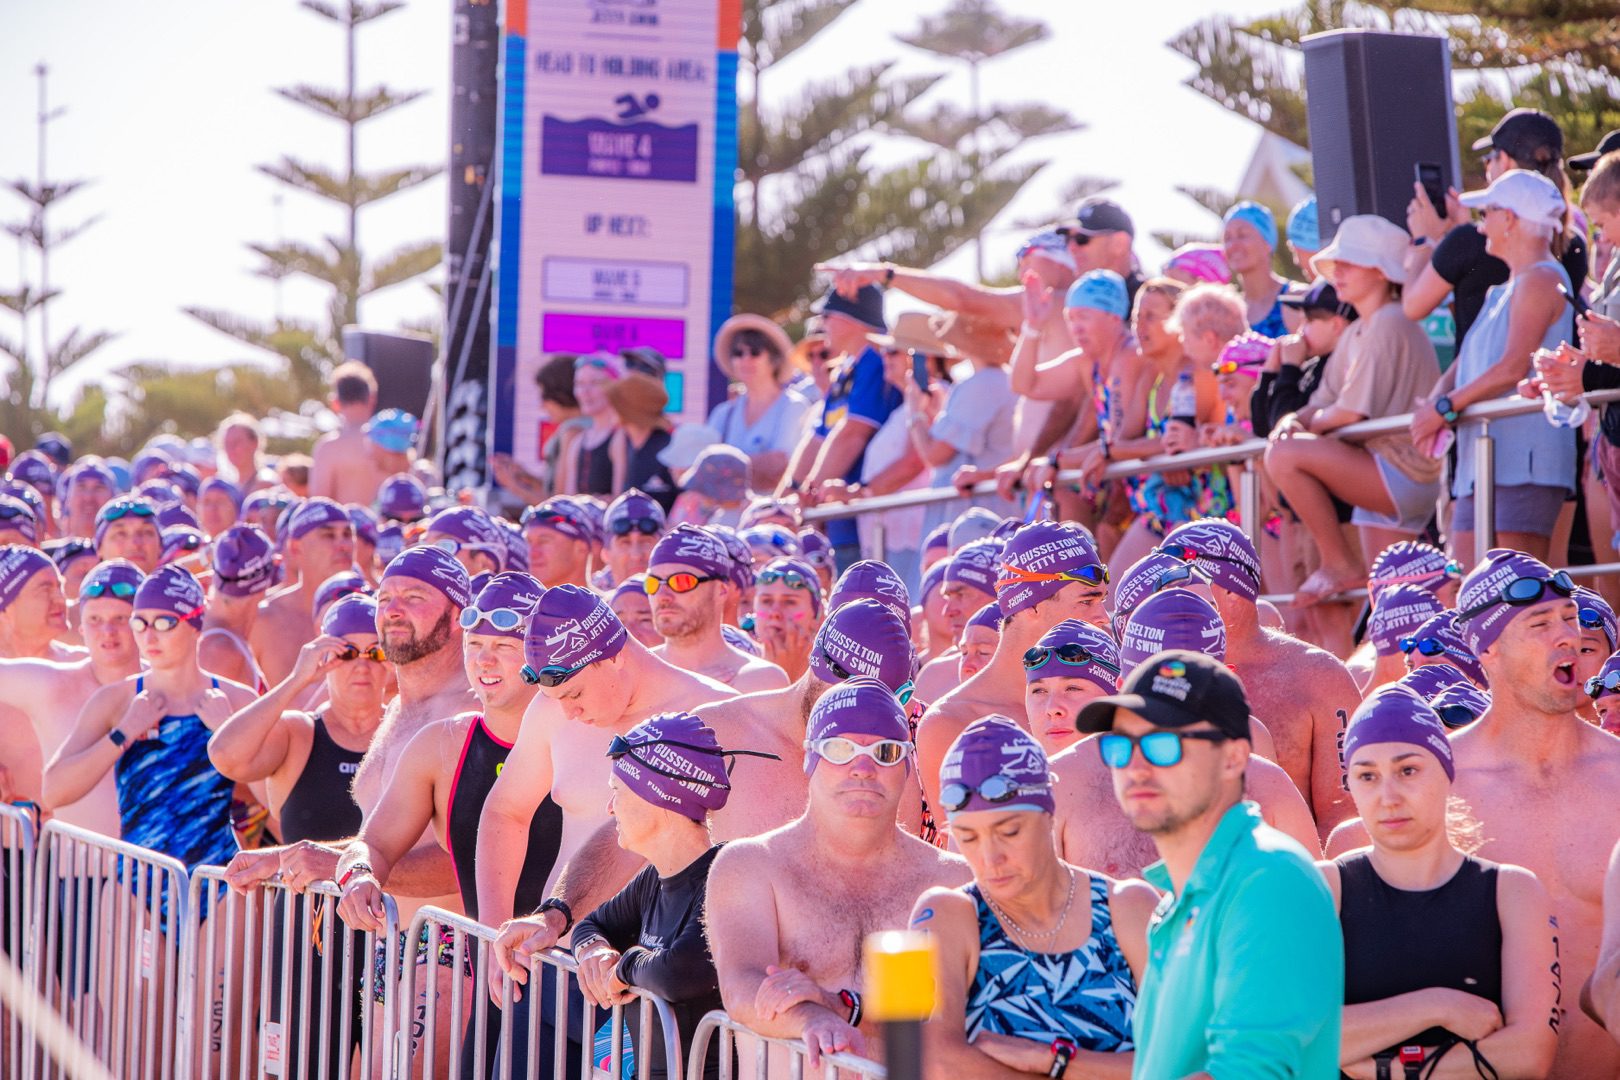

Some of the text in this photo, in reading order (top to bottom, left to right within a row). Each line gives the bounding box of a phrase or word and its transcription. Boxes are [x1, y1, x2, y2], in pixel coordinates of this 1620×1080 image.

[1020, 537, 1079, 565] BUSSELTON
[1058, 545, 1087, 561] SWIM
[1117, 564, 1163, 606] BUSSELTON
[1229, 574, 1256, 596] FUNKITA
[1461, 564, 1514, 607] BUSSELTON
[1488, 573, 1519, 596] SWIM
[1384, 602, 1432, 620] BUSSELTON
[1385, 614, 1410, 631] JETTY
[1482, 603, 1512, 630] FUNKITA
[590, 617, 611, 640] JETTY
[829, 629, 883, 665] BUSSELTON
[1135, 638, 1163, 654] SWIM
[823, 641, 849, 662] JETTY
[850, 656, 881, 679] SWIM
[1091, 665, 1116, 681] FUNKY
[827, 697, 858, 714] SWIM
[653, 743, 716, 783] BUSSELTON
[647, 781, 682, 804] FUNKITA
[679, 775, 710, 798] SWIM
